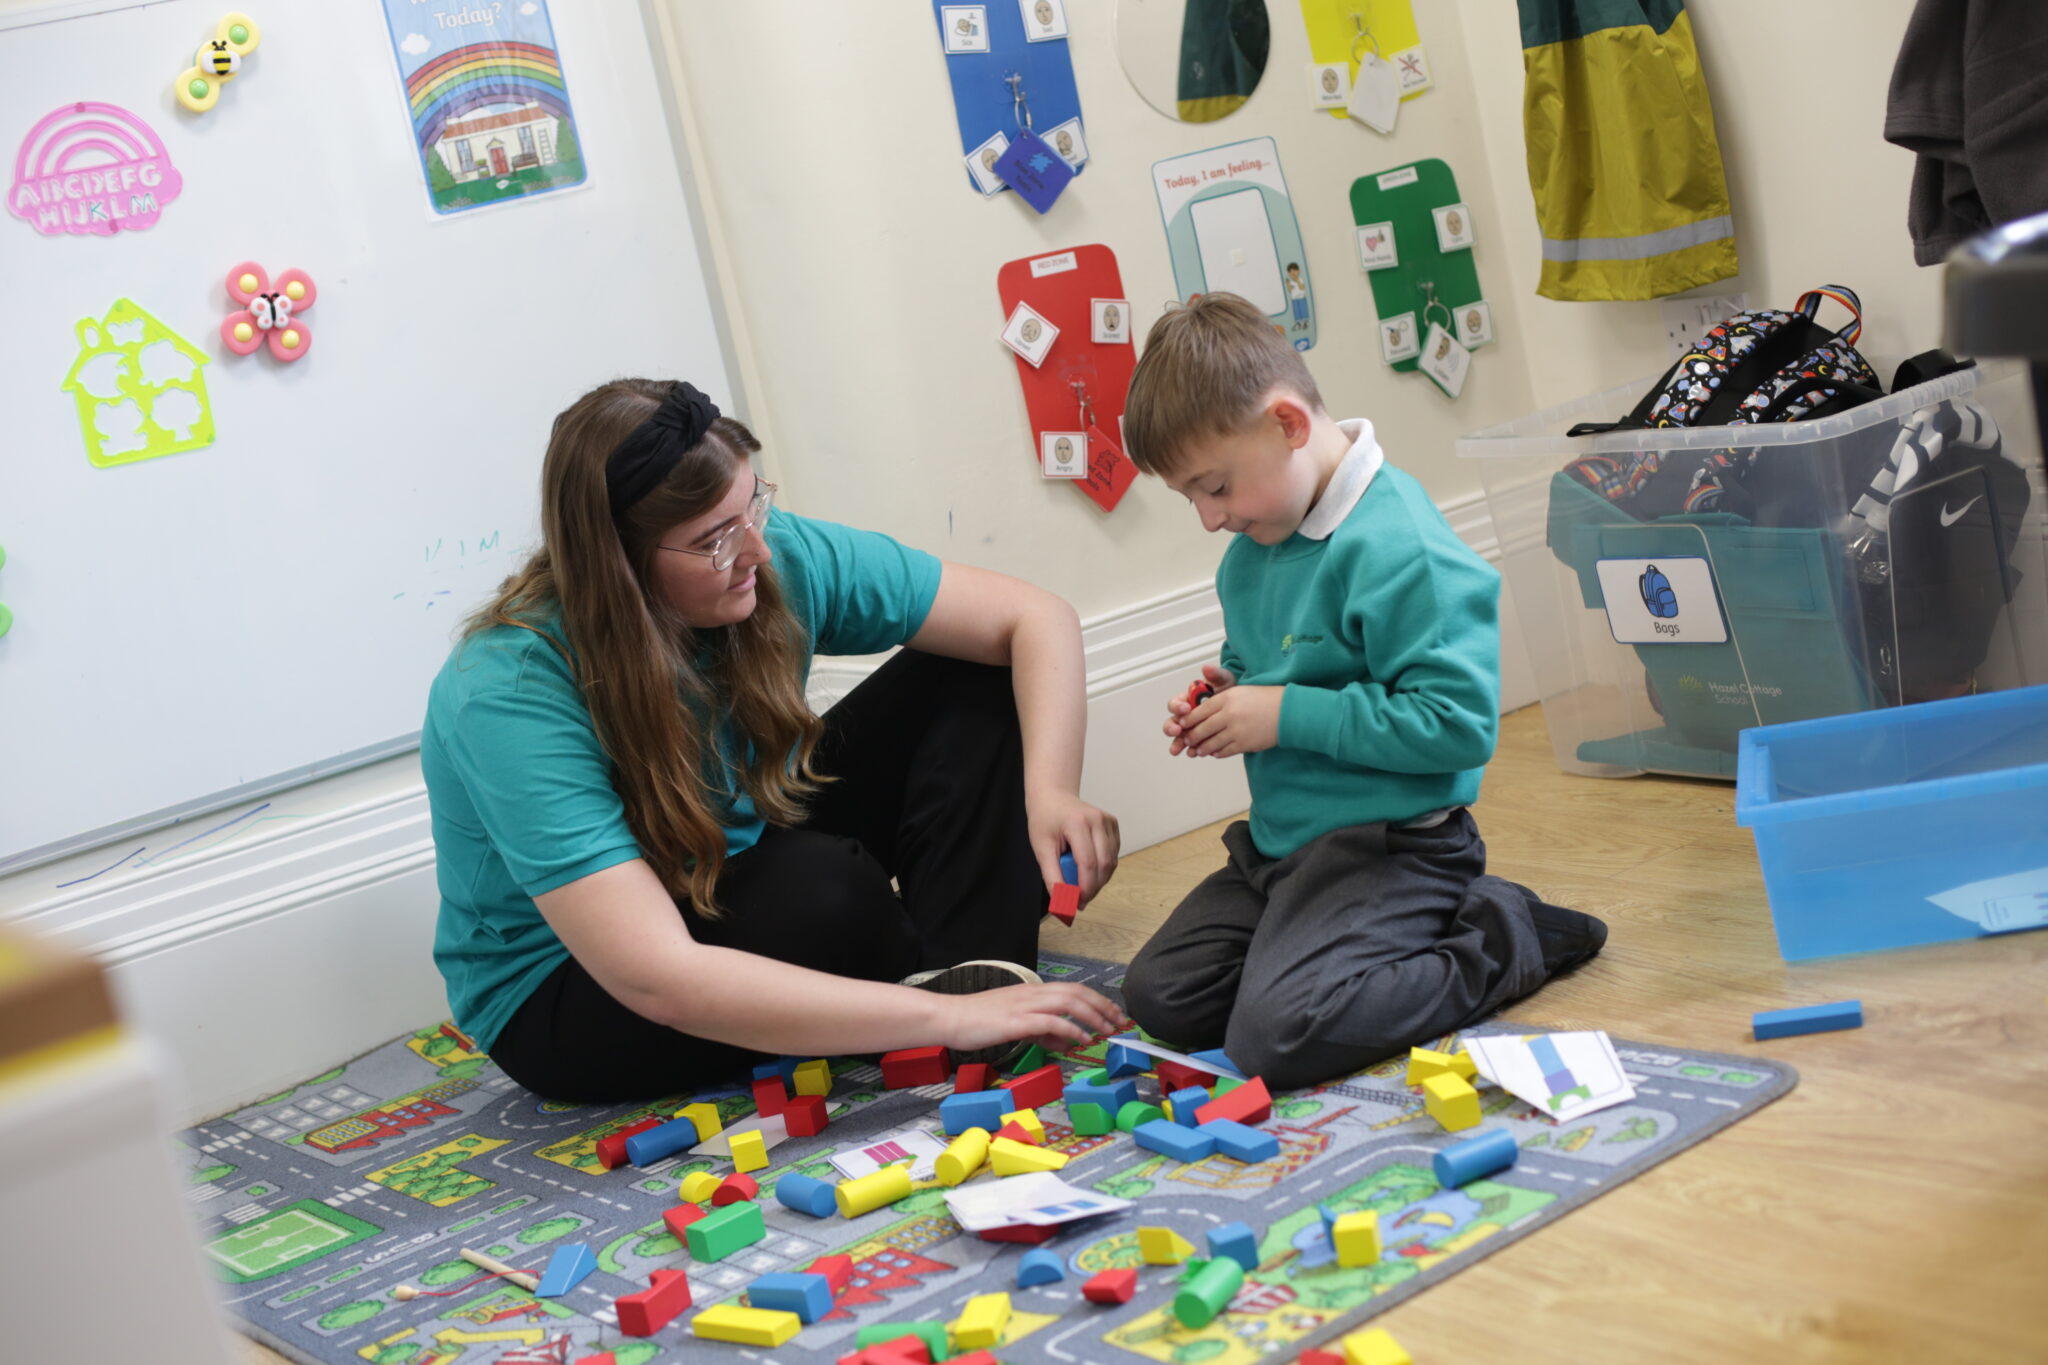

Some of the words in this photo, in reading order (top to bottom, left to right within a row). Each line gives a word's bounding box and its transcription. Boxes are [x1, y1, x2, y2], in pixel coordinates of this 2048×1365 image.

[433, 2, 502, 30] Today?
[1164, 175, 1200, 190] Today,
[1202, 170, 1208, 181] I
[1210, 168, 1226, 178] am
[1056, 464, 1073, 472] Angry
[1654, 621, 1680, 637] Bags
[1708, 681, 1738, 694] Hazel
[1715, 694, 1748, 705] School
